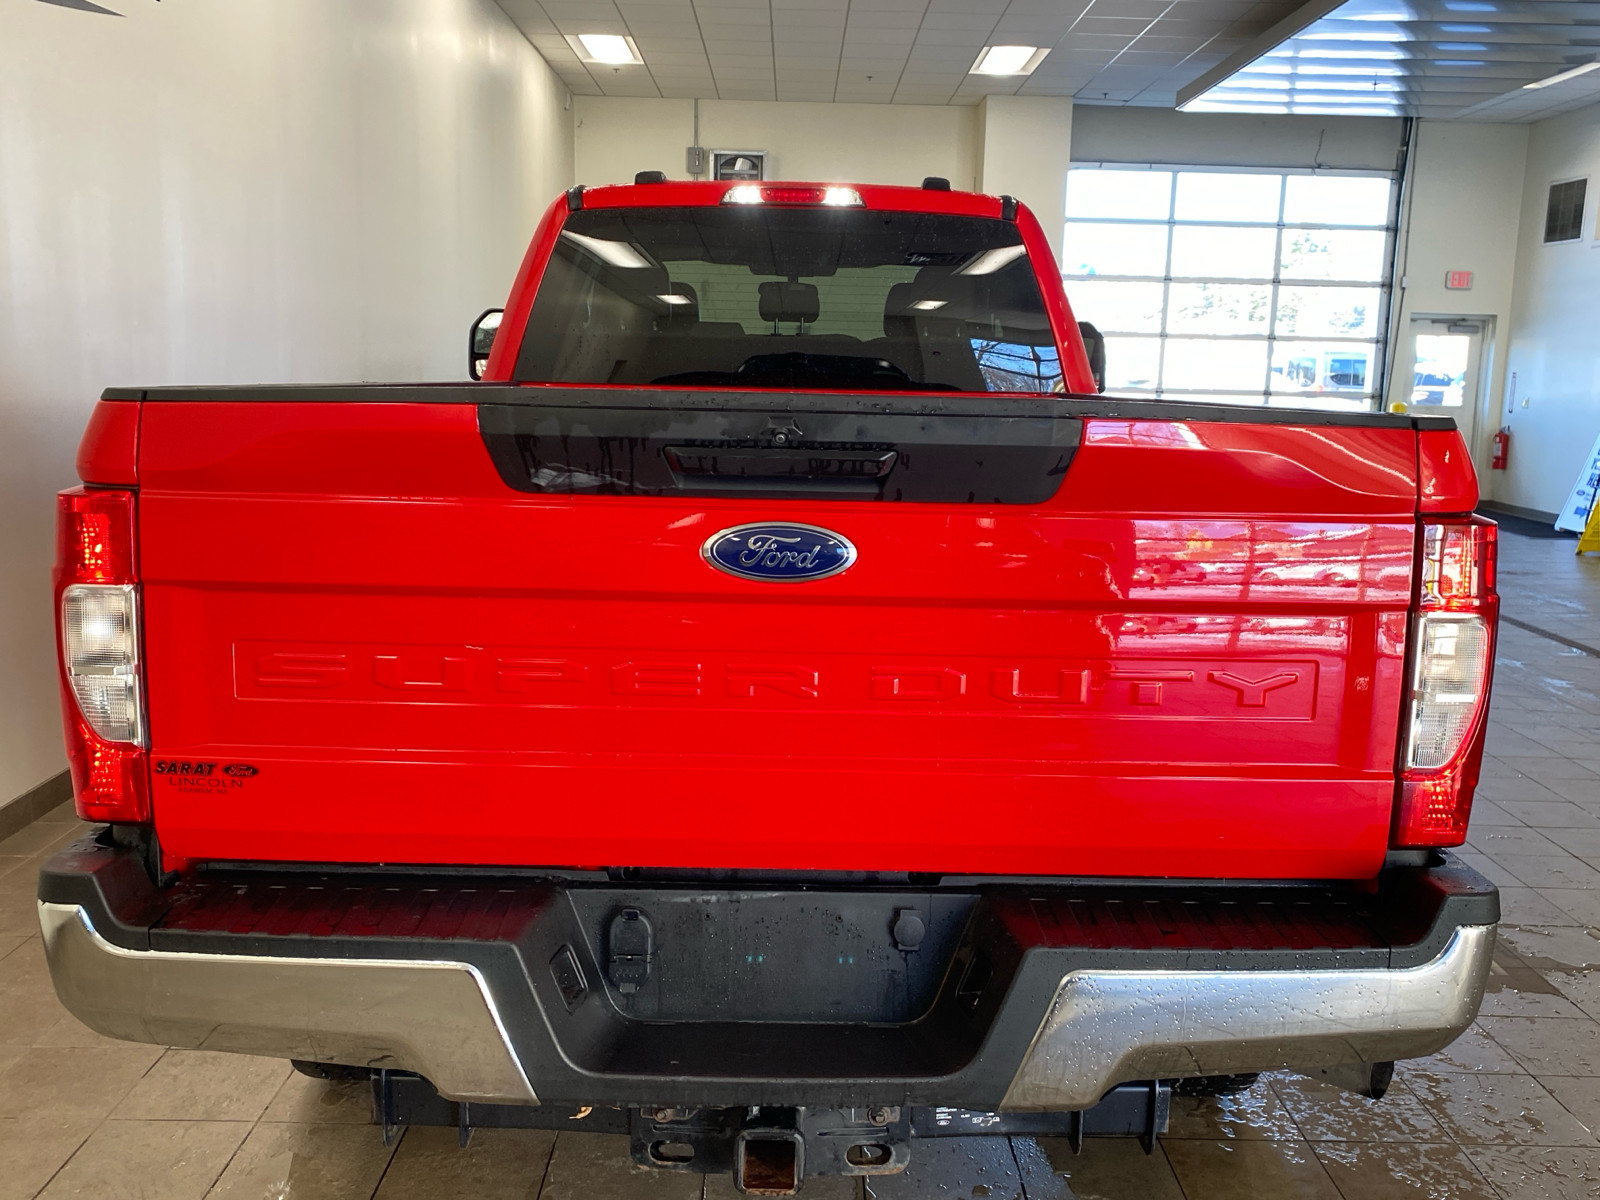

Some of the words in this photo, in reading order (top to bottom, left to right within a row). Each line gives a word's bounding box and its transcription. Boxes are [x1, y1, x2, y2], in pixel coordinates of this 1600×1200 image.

[1451, 270, 1472, 288] EXIT
[739, 534, 822, 569] Ford
[255, 652, 819, 698] SUPER
[871, 665, 1299, 708] DUTY
[154, 760, 218, 777] SARAT
[169, 776, 243, 788] LINCOLN
